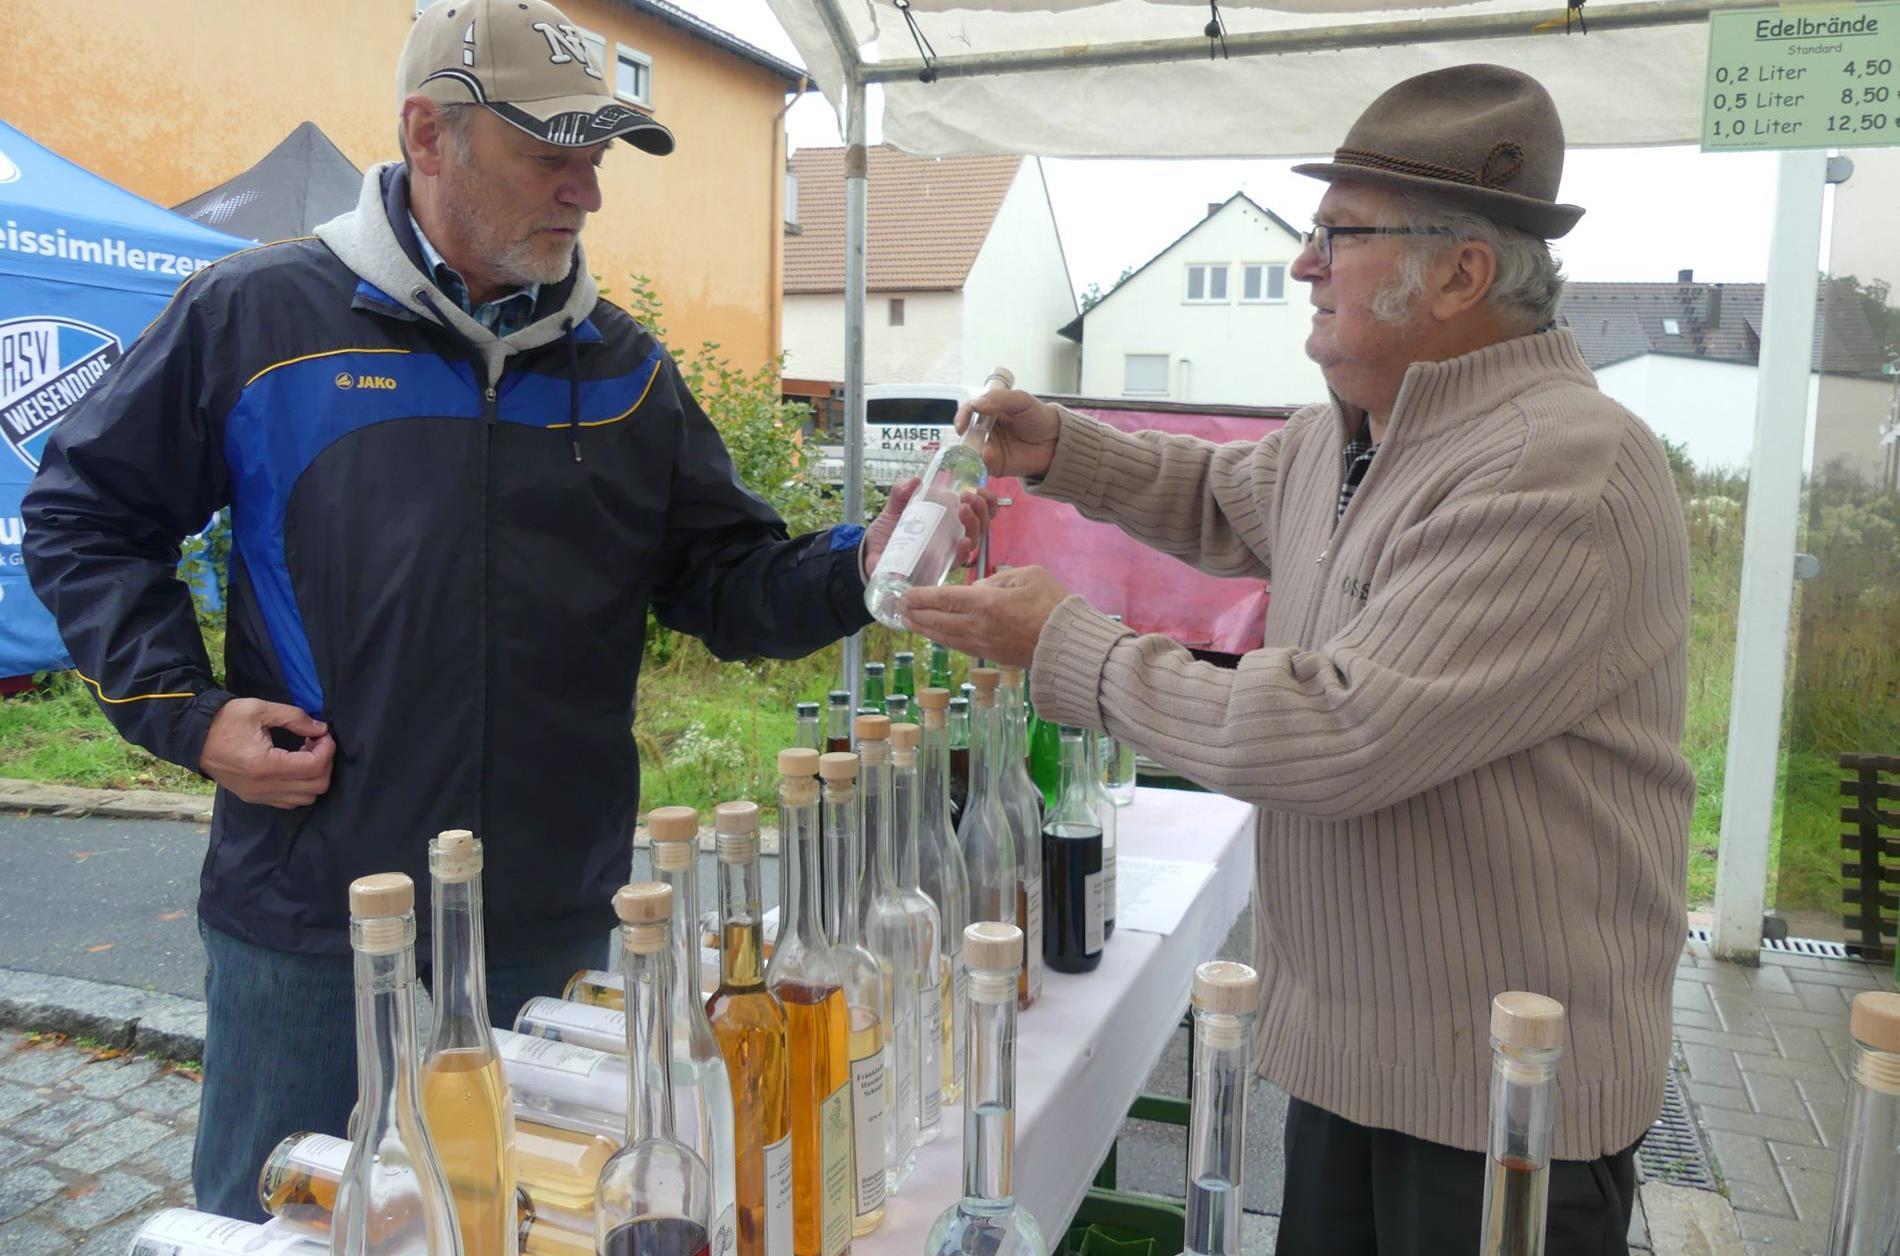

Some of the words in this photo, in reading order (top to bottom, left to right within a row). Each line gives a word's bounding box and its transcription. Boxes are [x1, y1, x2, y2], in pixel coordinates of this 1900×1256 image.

[1756, 14, 1878, 39] Edelbrände
[1788, 43, 1843, 55] Standard
[1716, 66, 1749, 85] 0,2
[1759, 65, 1807, 82] Liter
[1843, 59, 1892, 78] 4,50
[1713, 92, 1747, 112] 0,5
[1756, 92, 1805, 109] Liter
[1841, 86, 1889, 106] 8,50
[1713, 119, 1745, 138] 1,0
[1754, 119, 1803, 135] Liter
[1827, 113, 1887, 133] 12,50
[3, 330, 49, 397] ASV
[356, 375, 397, 390] JAKO
[882, 427, 941, 441] KAISER
